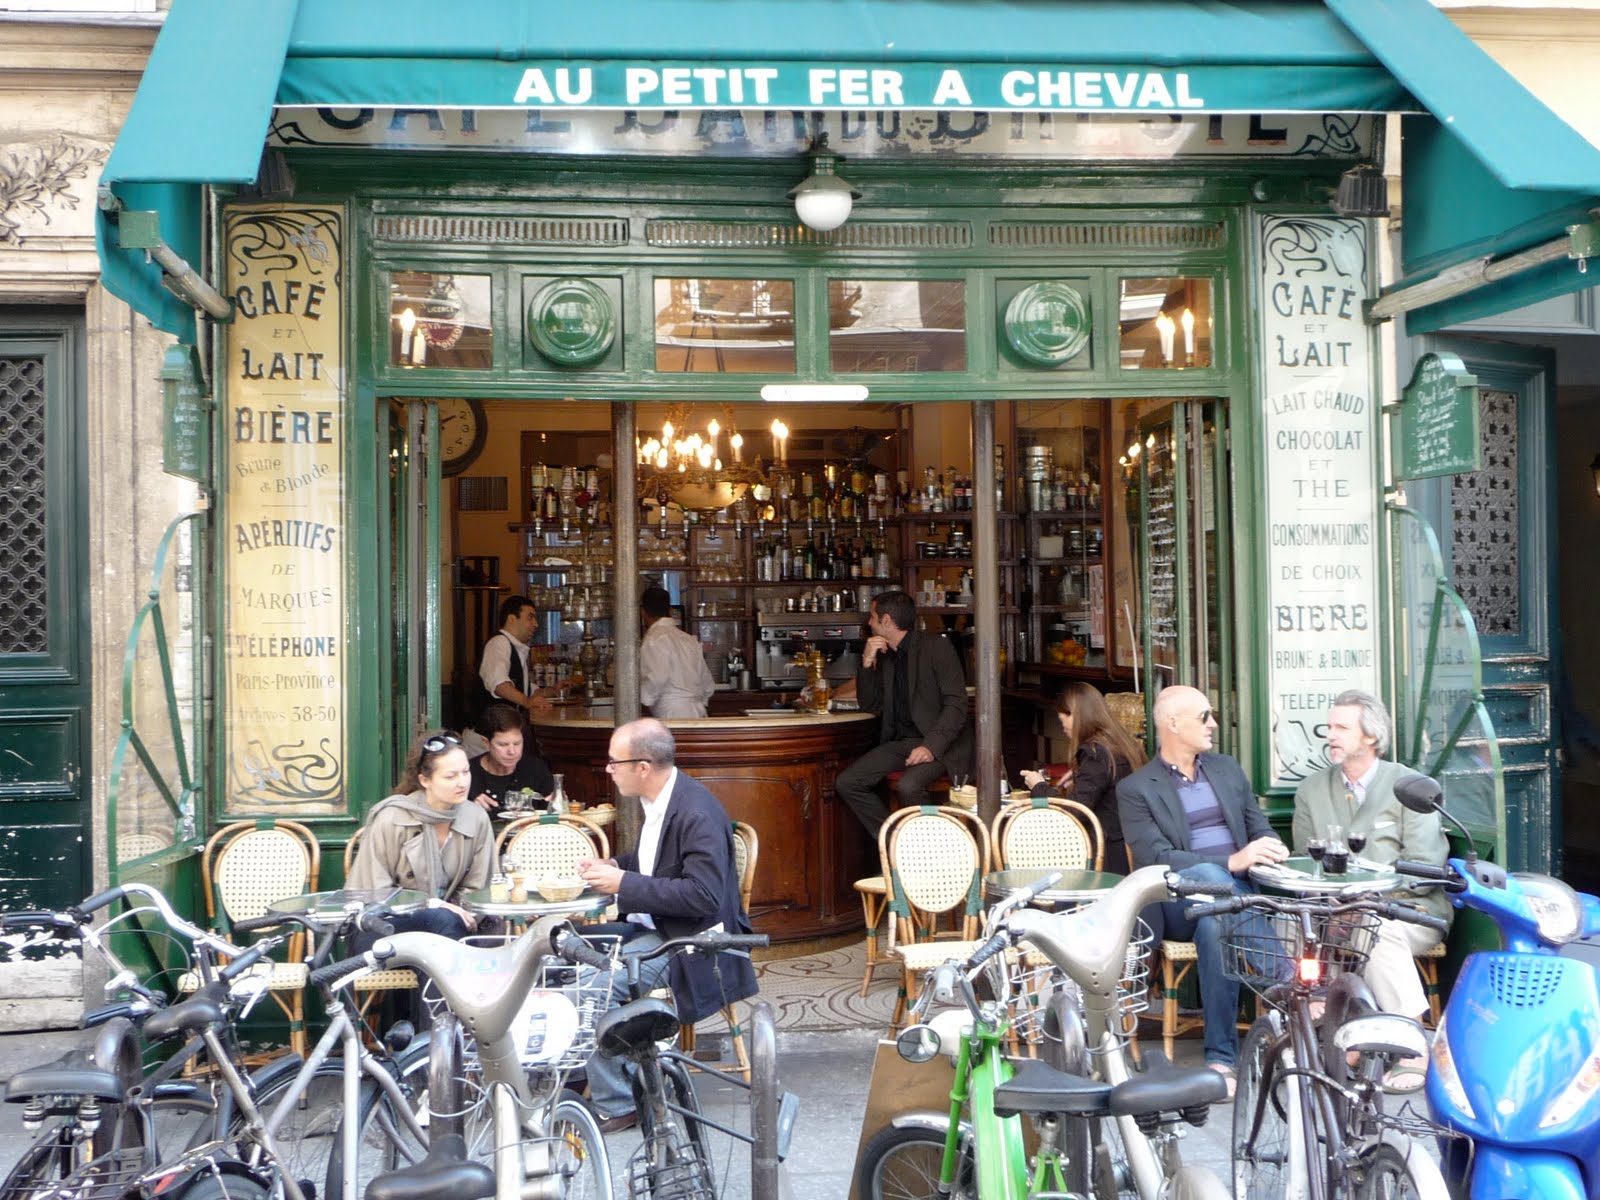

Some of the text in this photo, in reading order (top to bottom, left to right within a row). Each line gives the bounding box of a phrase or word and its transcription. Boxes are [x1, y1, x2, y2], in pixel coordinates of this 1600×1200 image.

[513, 68, 1204, 108] AU PETIT FER A CHEVAL
[236, 280, 327, 322] CAFÉ
[272, 328, 297, 339] ET
[1304, 324, 1328, 333] ET
[1277, 335, 1352, 367] LAIT
[241, 347, 324, 381] LAIT
[1272, 390, 1365, 416] LAIT CHAUD
[234, 404, 334, 444] BIÈRE
[1276, 430, 1363, 451] CHOCOLAT
[235, 455, 282, 479] Brune
[1309, 460, 1332, 470] ET
[275, 462, 331, 494] Blonde
[1293, 479, 1350, 498] THE
[236, 515, 336, 554] APÉRITIFS
[1272, 523, 1369, 547] CONSOMMATIONS
[271, 563, 296, 576] DE
[1281, 564, 1363, 580] DE CHOIX
[239, 587, 333, 612] MARQUES
[1275, 604, 1369, 632] BIERE
[236, 633, 336, 658] TÉLÉPHONE
[1276, 649, 1372, 669] BRUNE & BLONDE
[236, 671, 336, 690] Paris-Province
[1279, 693, 1336, 710] TELEPH
[291, 706, 336, 722] 38-50
